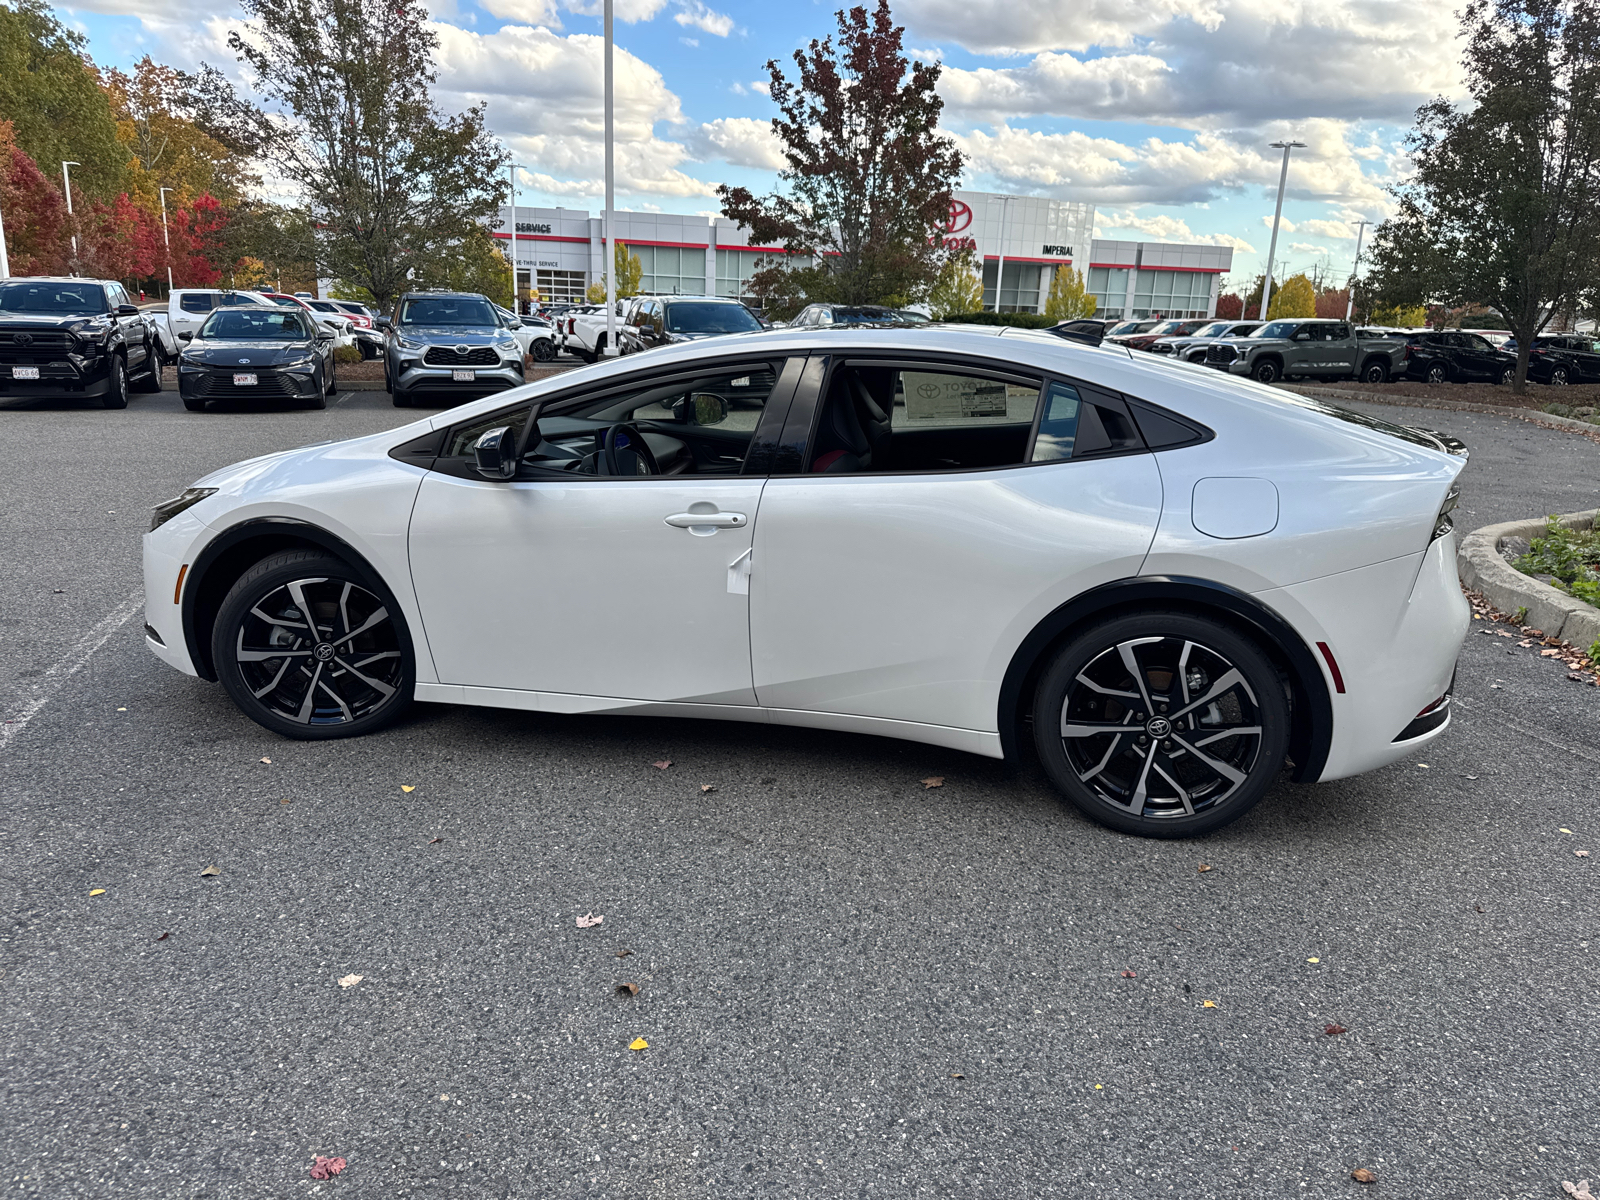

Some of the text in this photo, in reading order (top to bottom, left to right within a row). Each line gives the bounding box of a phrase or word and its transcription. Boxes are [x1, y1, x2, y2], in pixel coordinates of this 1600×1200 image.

[515, 222, 551, 234] SERVICE
[1042, 244, 1074, 257] IMPERIAL
[943, 381, 993, 391] TOYOTA
